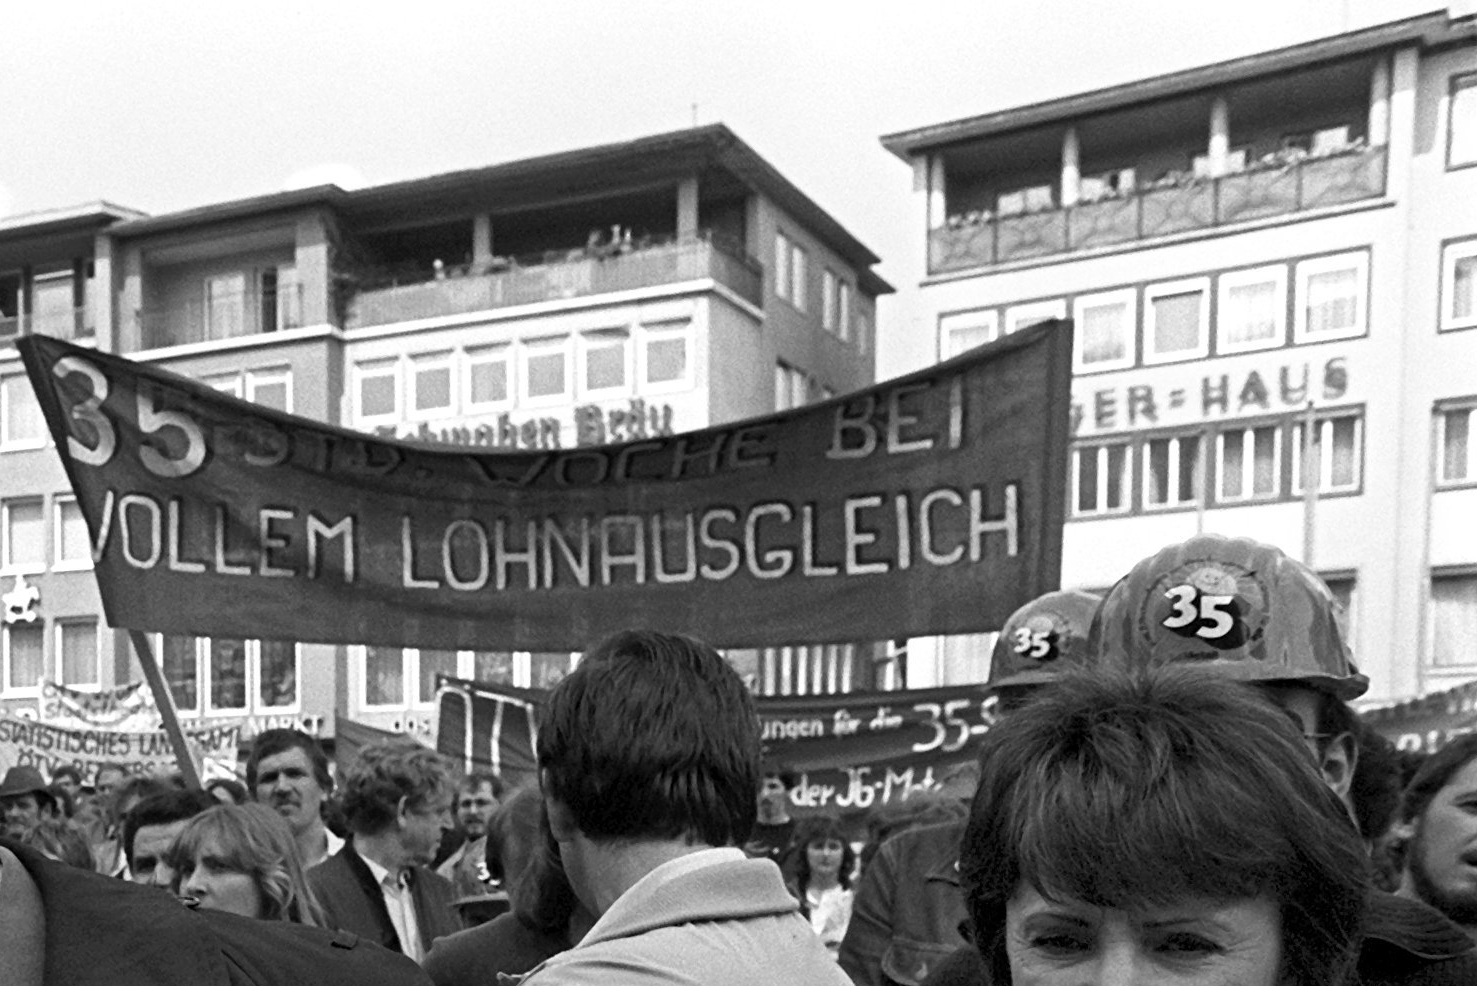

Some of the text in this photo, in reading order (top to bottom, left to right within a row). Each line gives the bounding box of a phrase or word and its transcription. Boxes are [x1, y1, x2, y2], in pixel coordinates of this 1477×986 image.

[52, 355, 207, 478] 35
[825, 374, 964, 460] BEI
[401, 483, 1019, 592] LOHNAUSGLEICH
[1013, 627, 1052, 659] 35
[1162, 584, 1235, 639] 35
